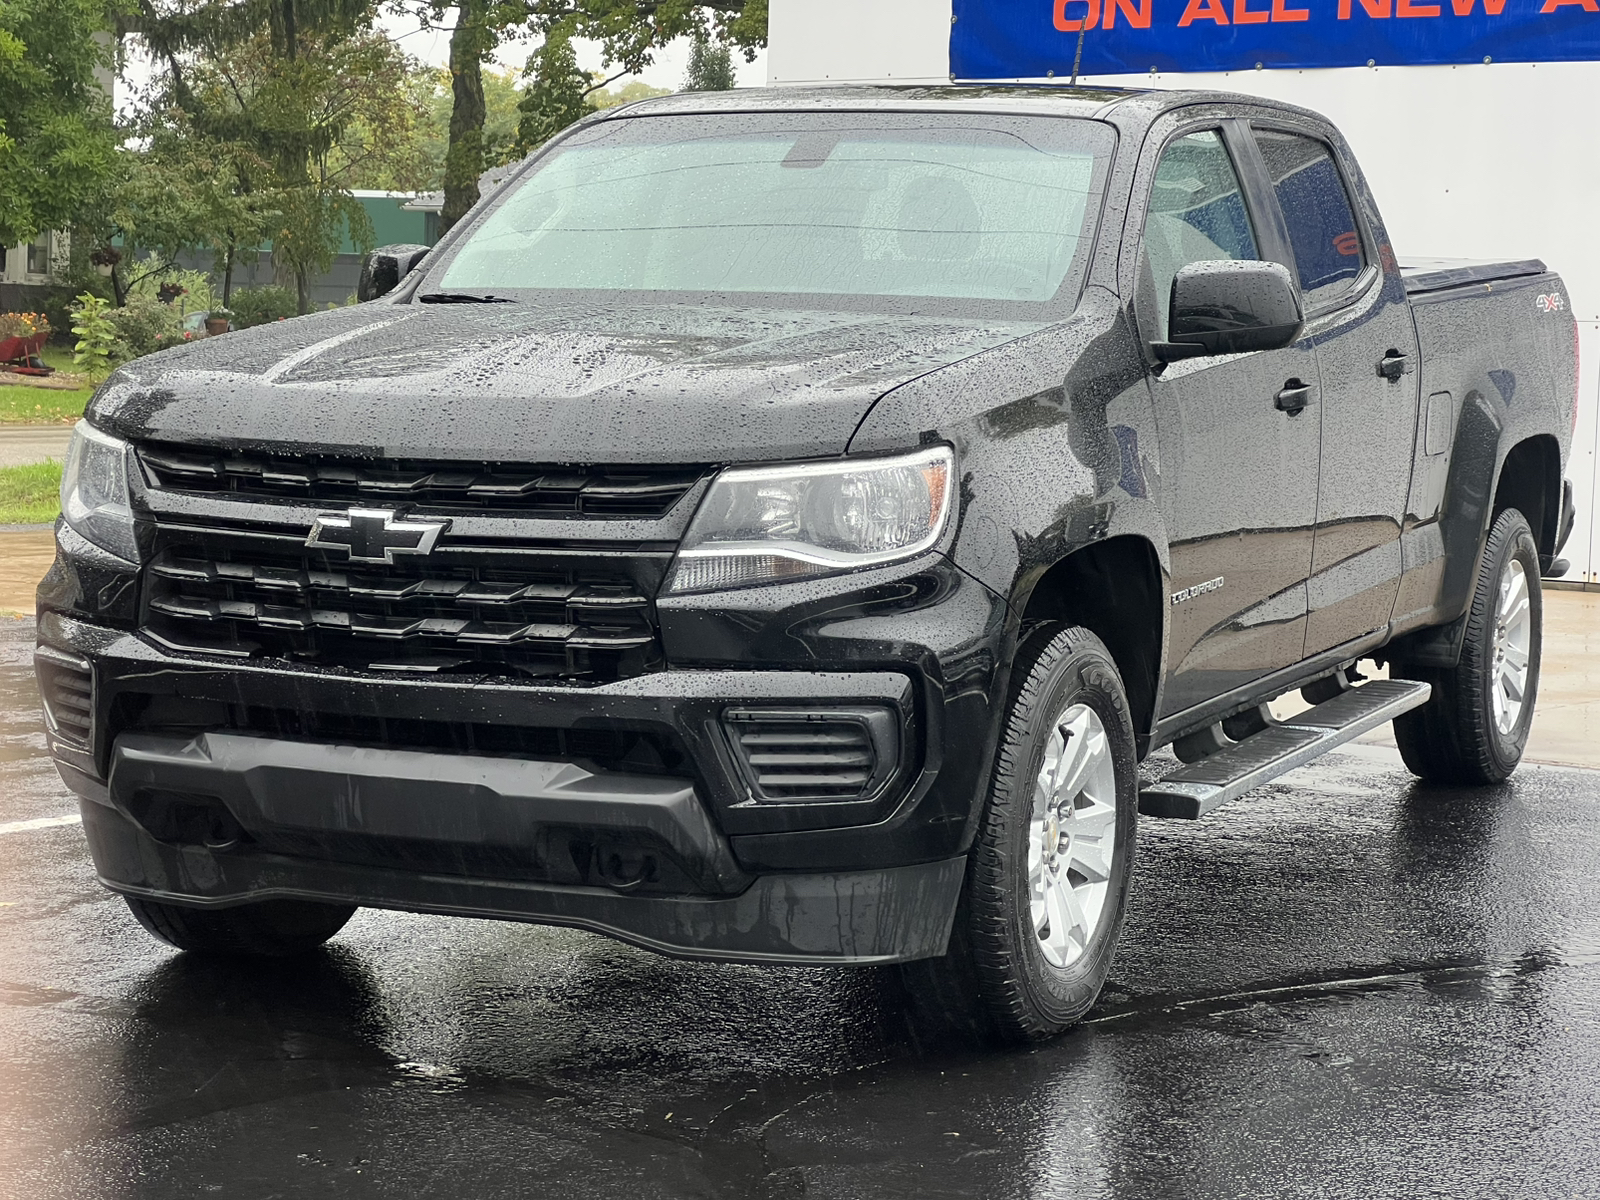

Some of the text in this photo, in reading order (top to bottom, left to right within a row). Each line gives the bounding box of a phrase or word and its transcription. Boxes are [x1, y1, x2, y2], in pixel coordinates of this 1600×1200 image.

[1053, 0, 1152, 32] ON
[1177, 0, 1309, 27] ALL
[1171, 576, 1224, 604] COLORADO
